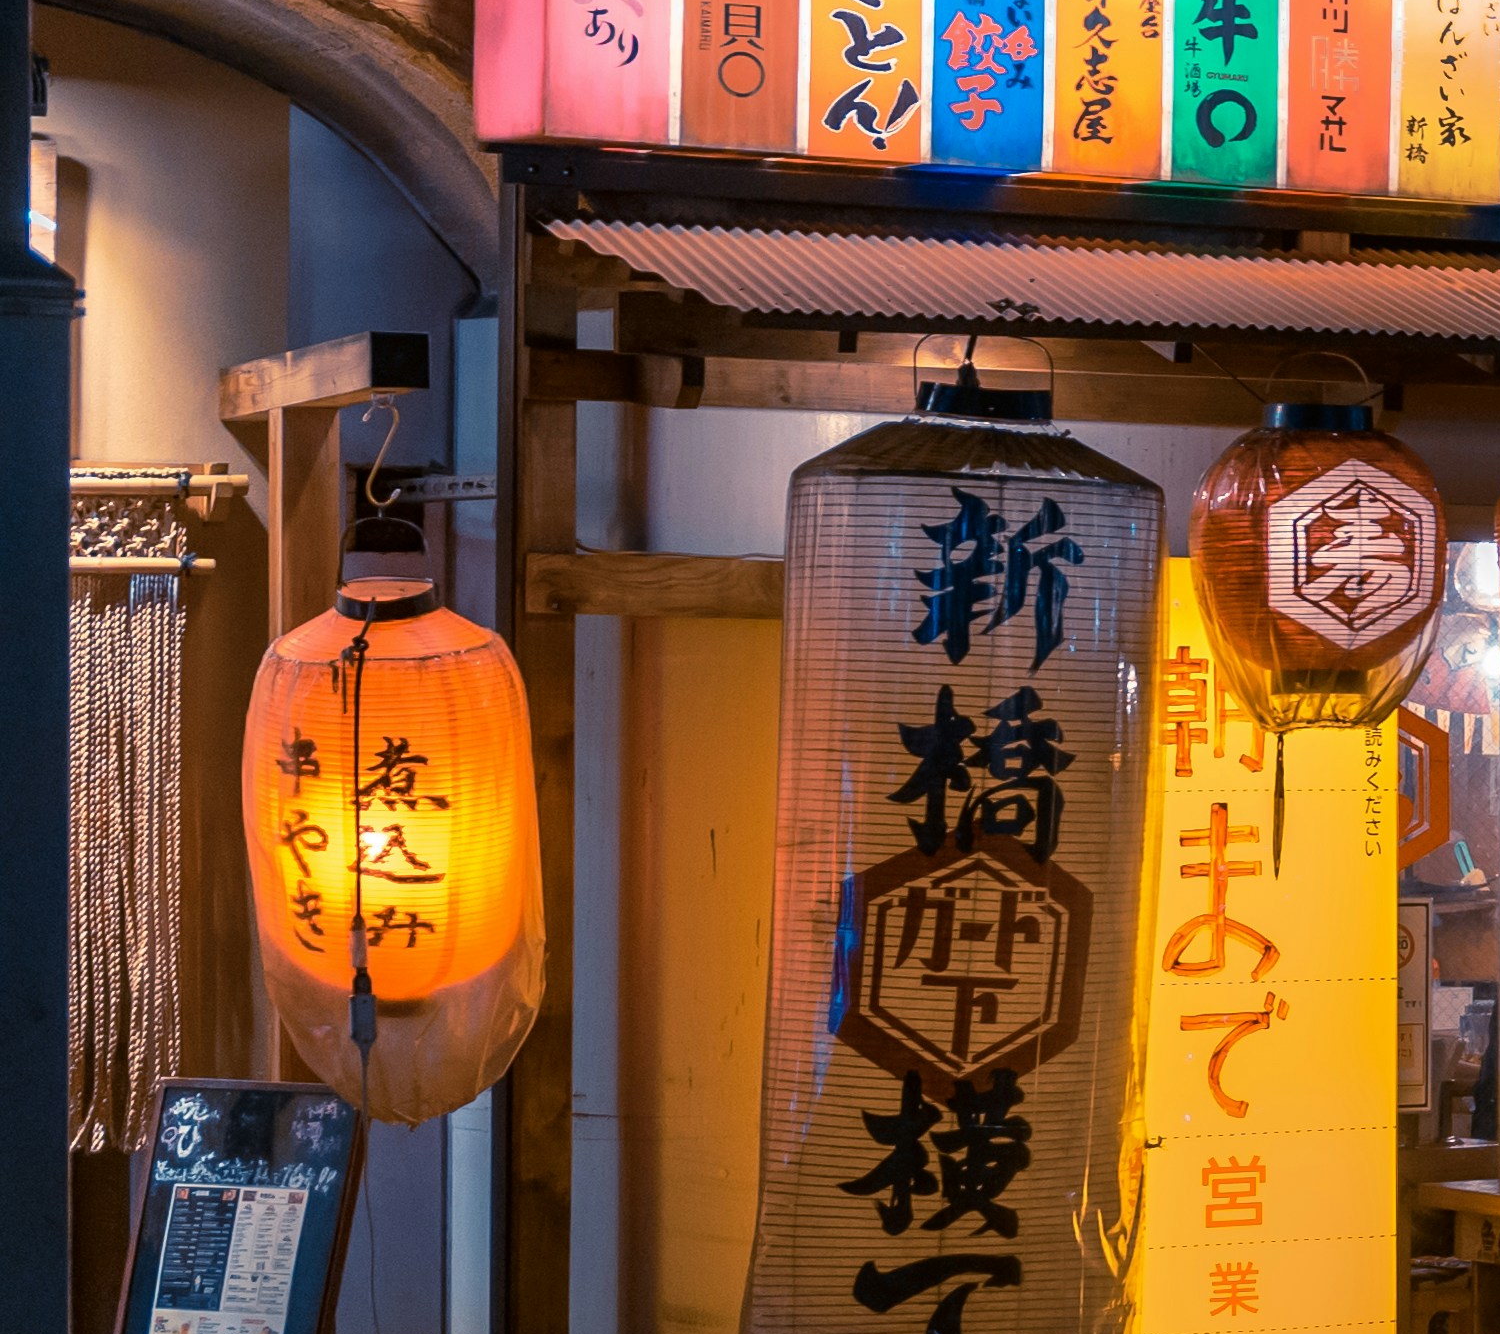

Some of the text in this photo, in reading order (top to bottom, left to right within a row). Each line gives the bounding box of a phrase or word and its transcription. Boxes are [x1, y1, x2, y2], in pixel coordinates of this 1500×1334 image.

[701, 0, 712, 52] KAIMARU
[941, 10, 1007, 132] 餃子
[1404, 113, 1429, 165] 新橋
[275, 726, 331, 954] 串やき
